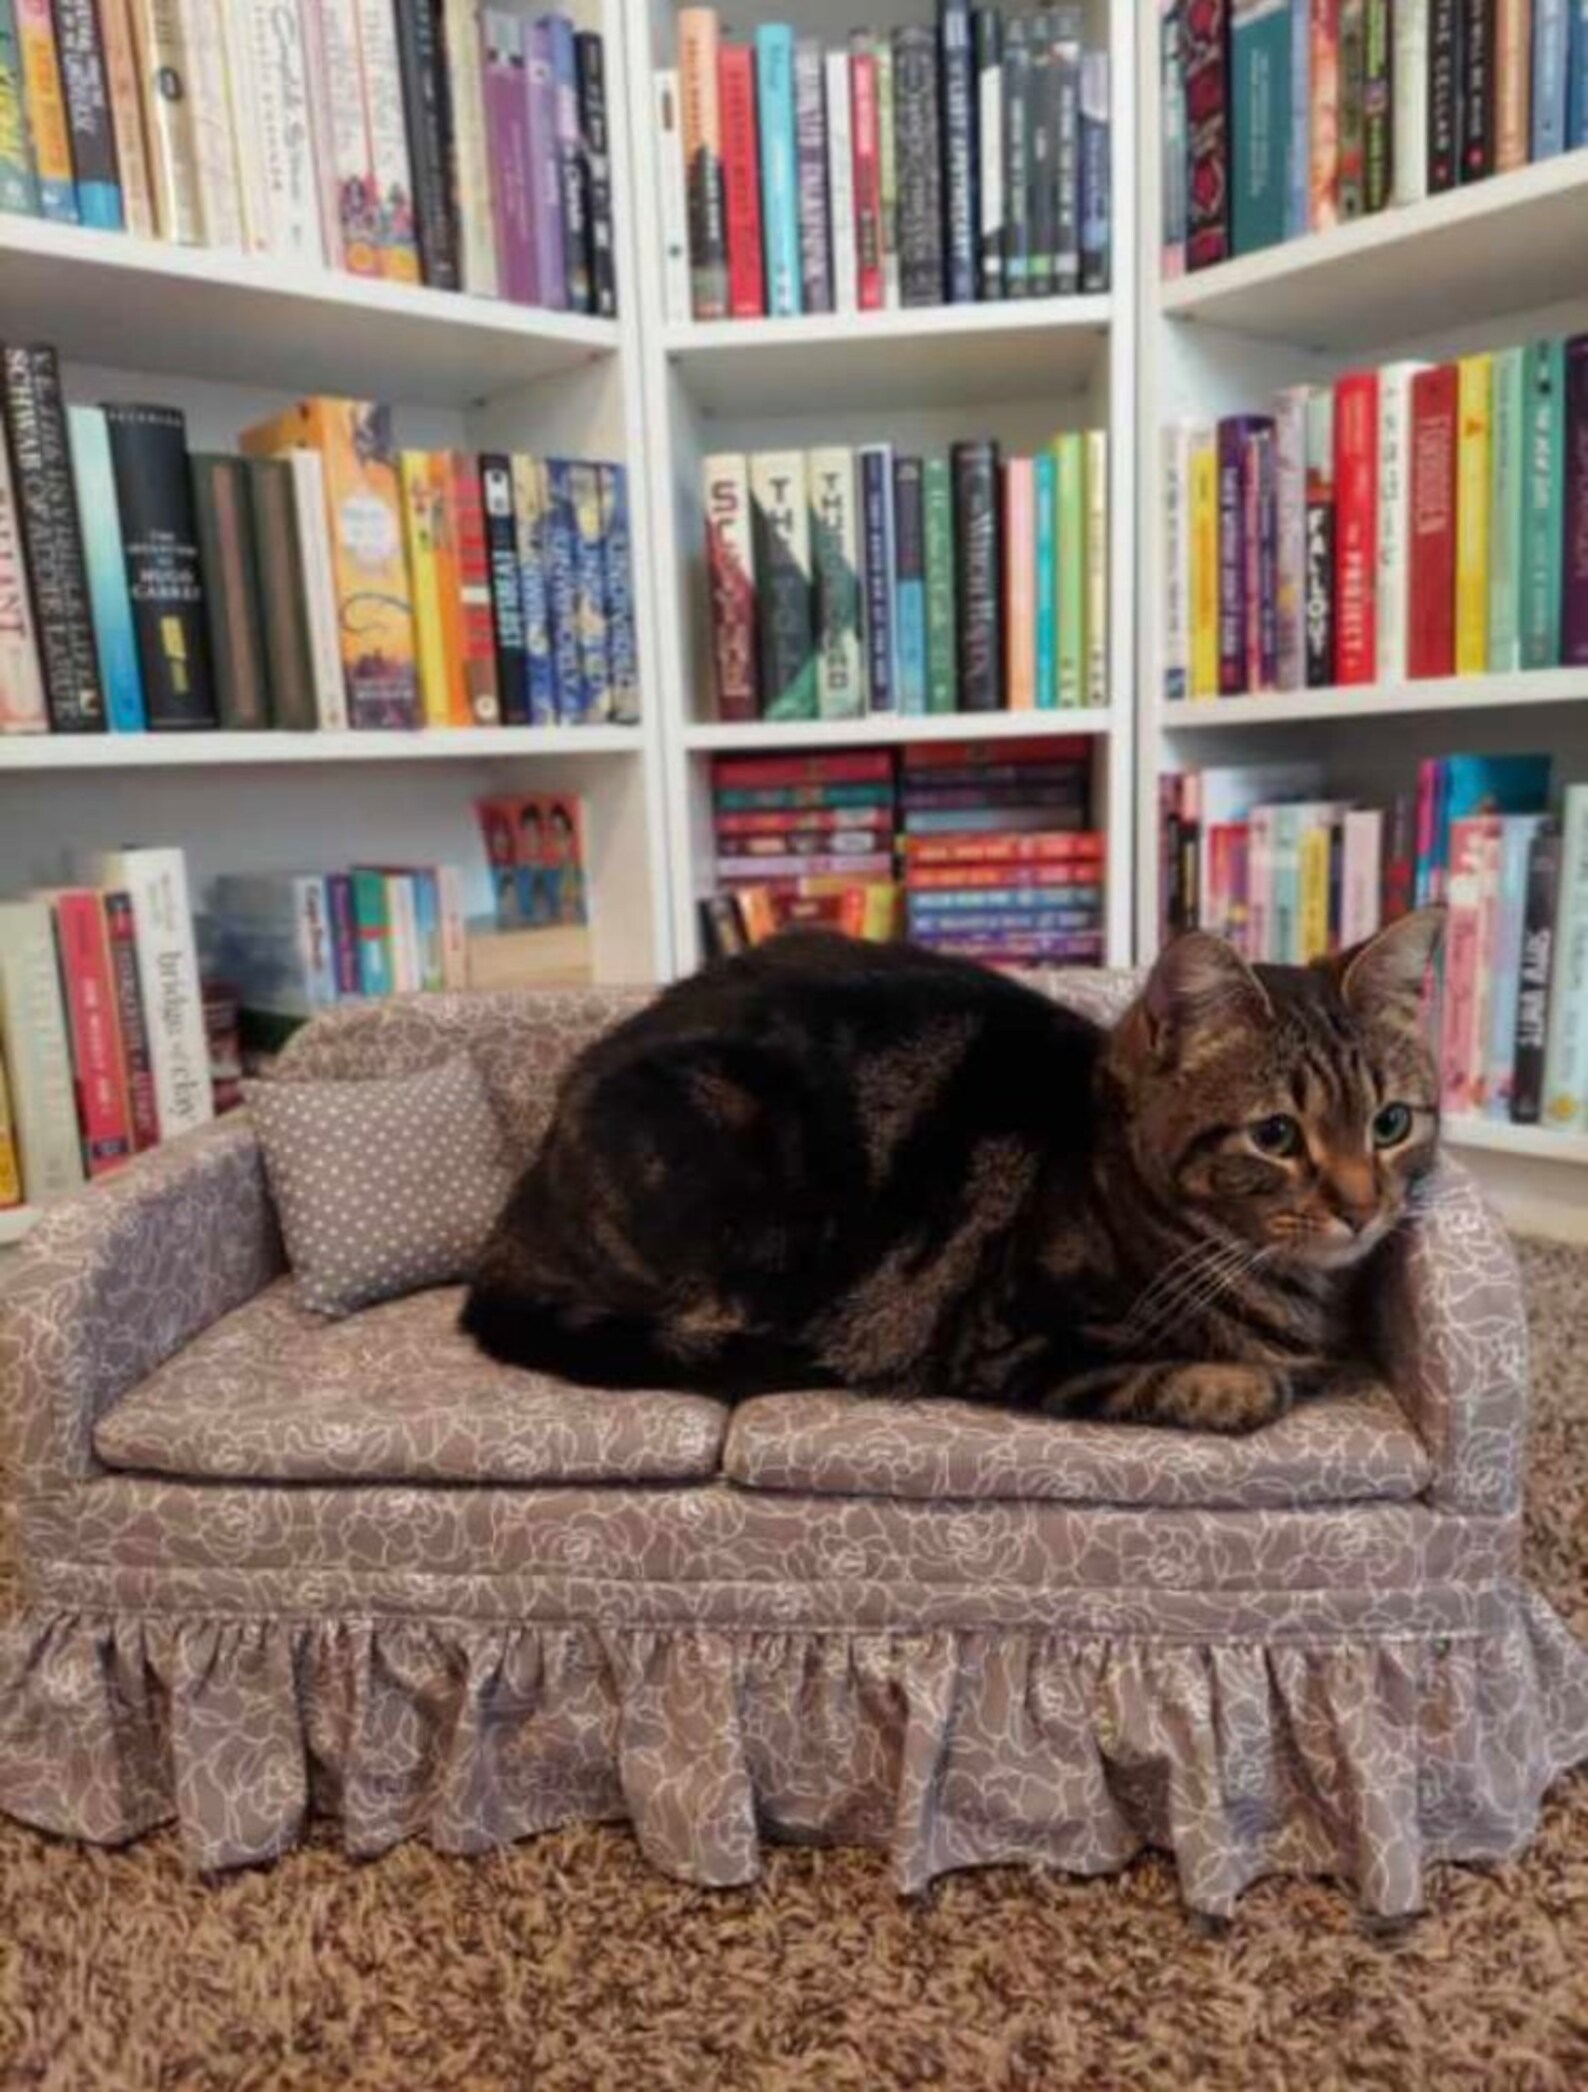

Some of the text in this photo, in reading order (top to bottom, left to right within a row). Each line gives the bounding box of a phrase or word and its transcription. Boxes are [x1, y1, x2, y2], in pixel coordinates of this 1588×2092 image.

[4, 349, 43, 469] SCHWAB
[157, 951, 186, 1036] bridge
[167, 1066, 201, 1121] clay
